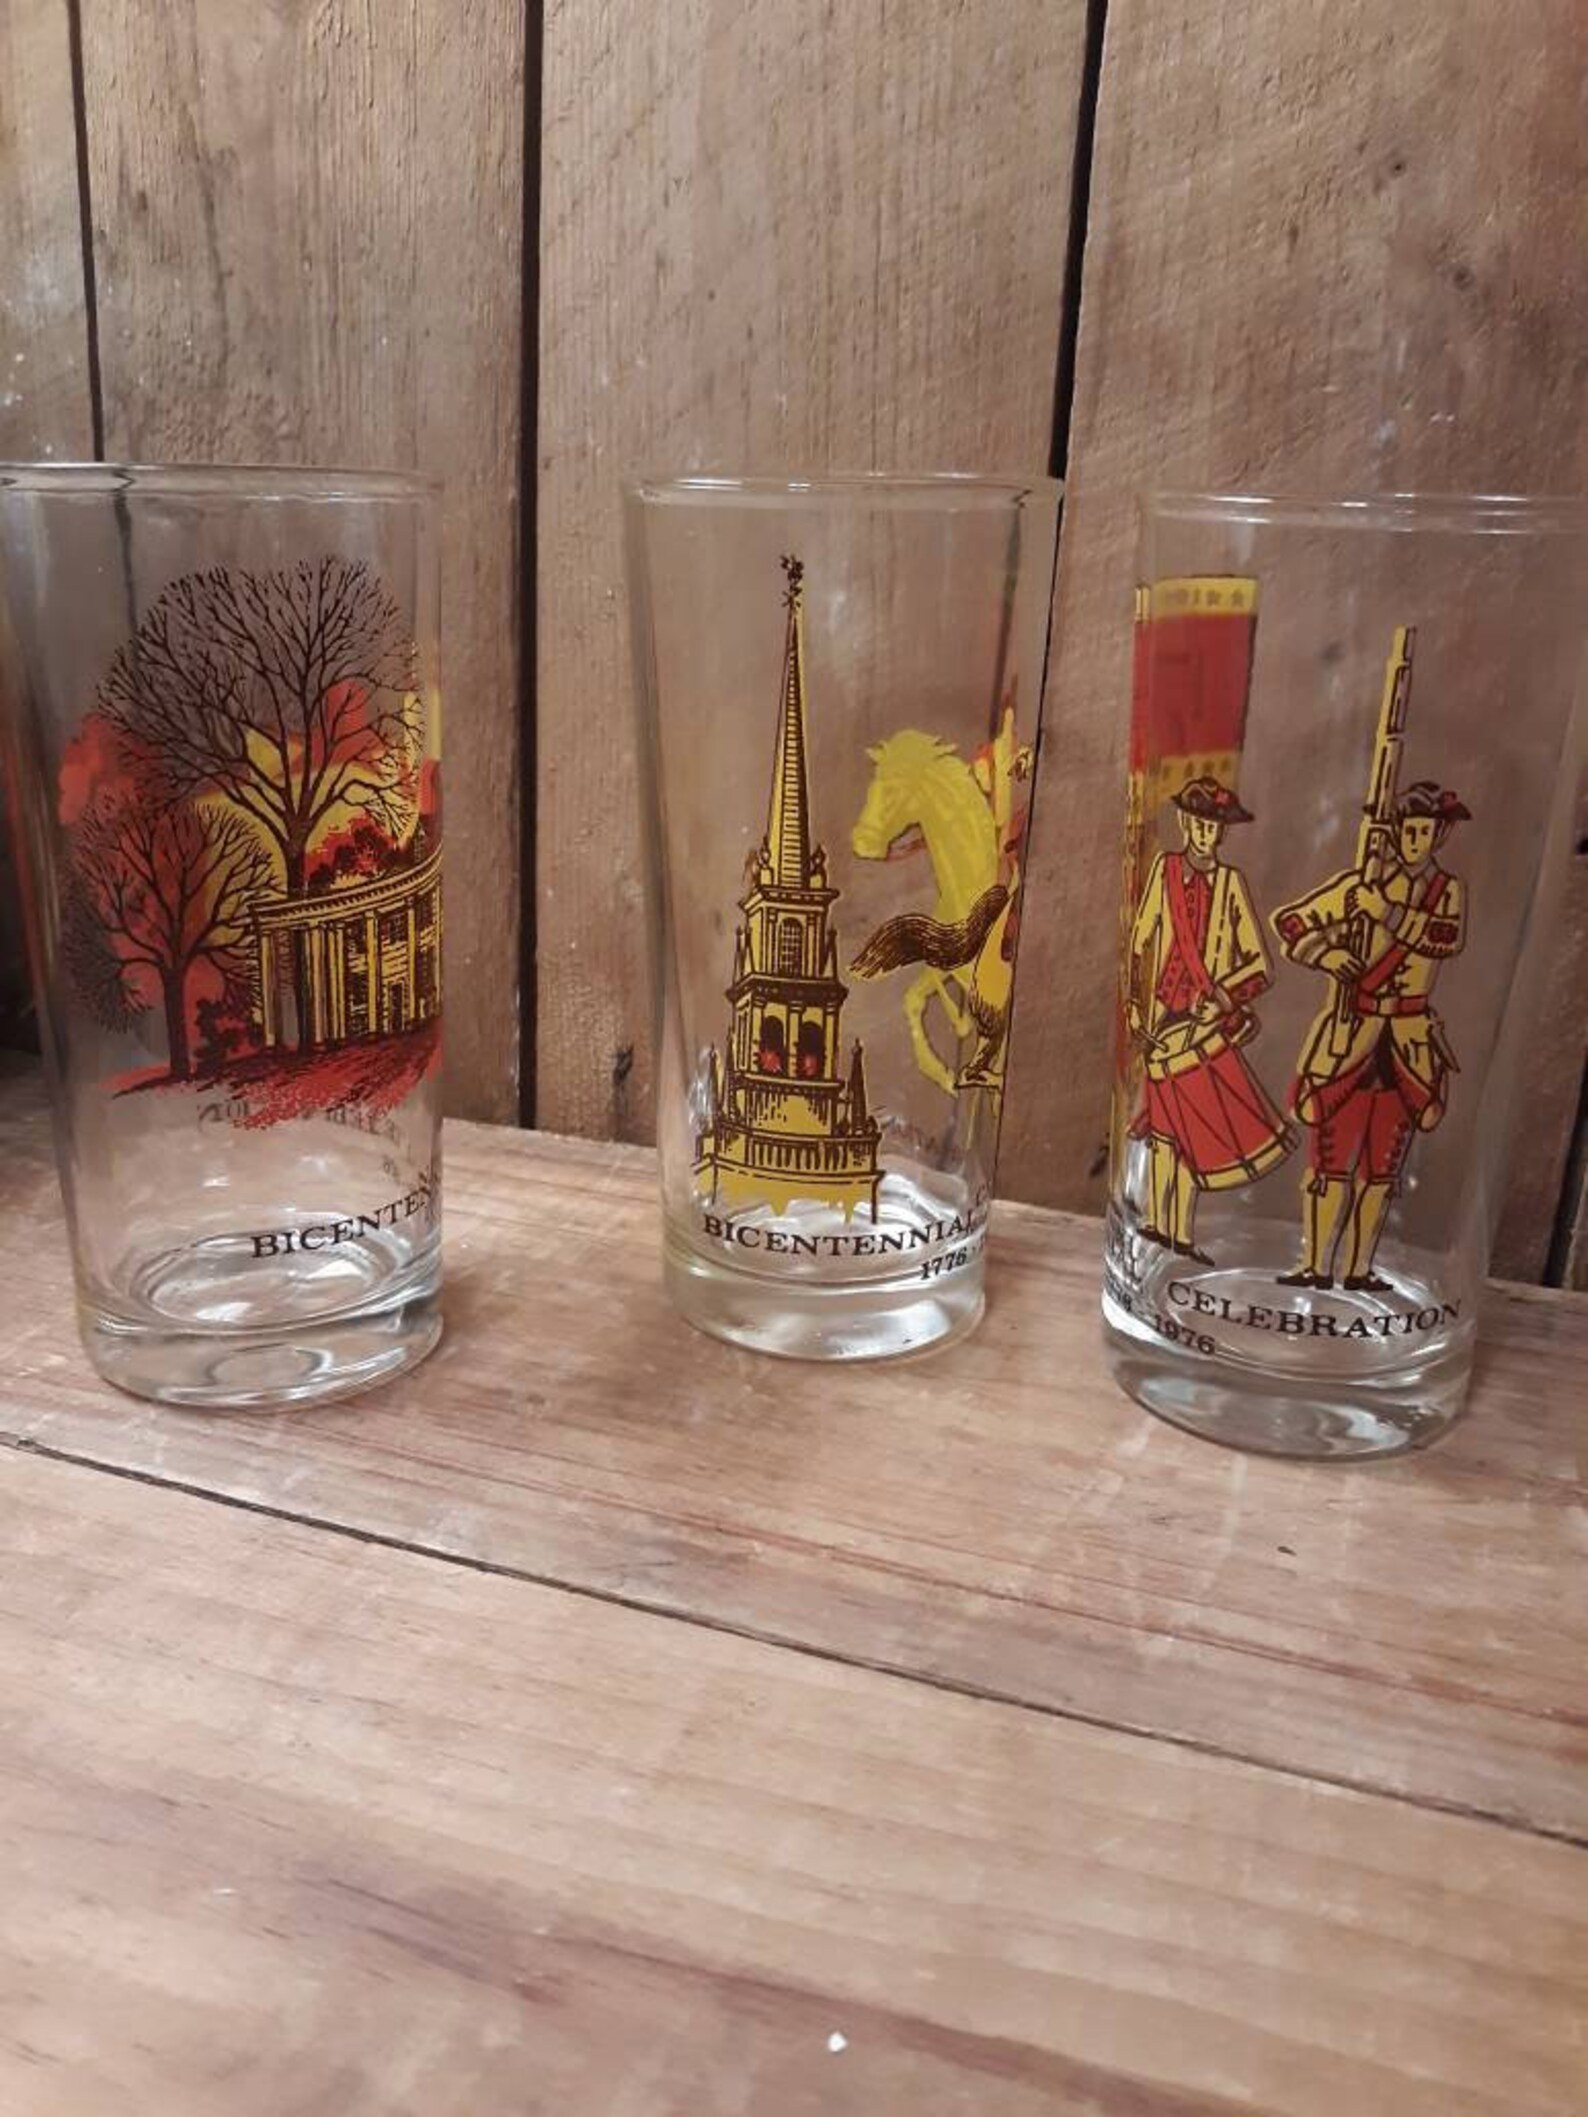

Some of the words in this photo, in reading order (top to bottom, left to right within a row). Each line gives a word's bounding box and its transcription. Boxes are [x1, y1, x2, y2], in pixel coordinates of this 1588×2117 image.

[703, 1210, 974, 1256] BICENTENNIAL
[920, 1247, 968, 1280] 1776
[1167, 1281, 1462, 1338] CELEBRATION
[1154, 1314, 1215, 1354] 1976
